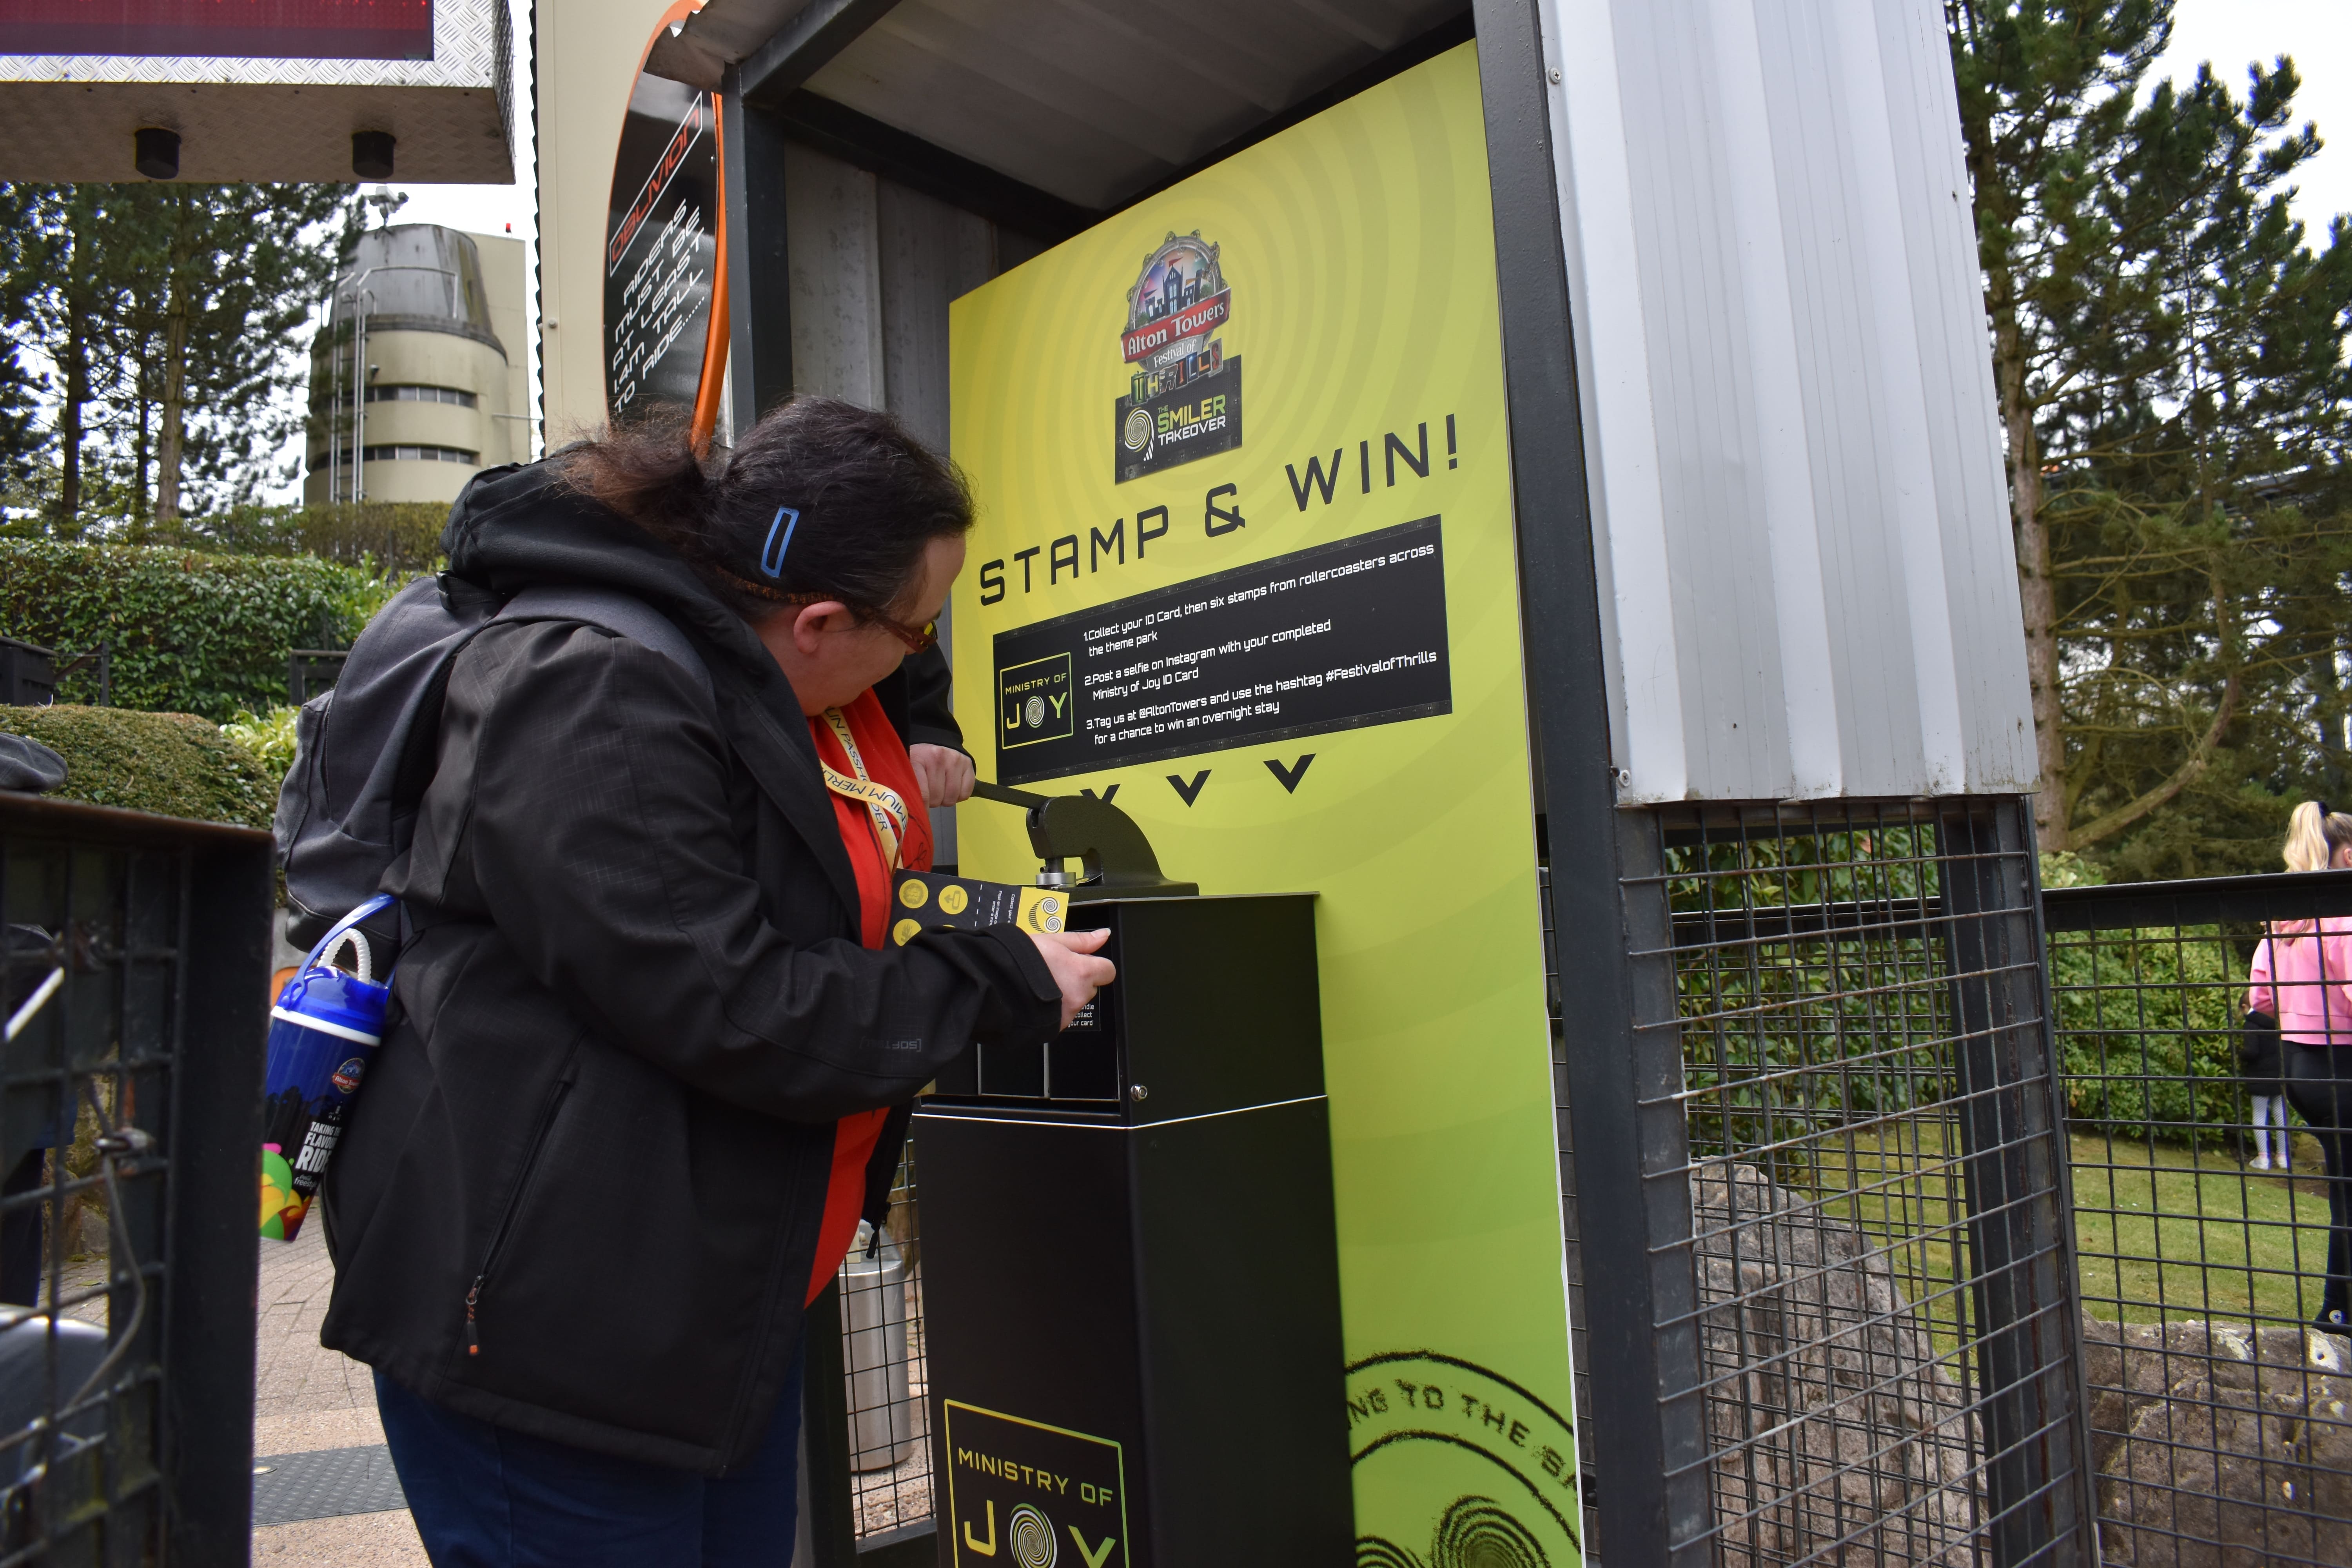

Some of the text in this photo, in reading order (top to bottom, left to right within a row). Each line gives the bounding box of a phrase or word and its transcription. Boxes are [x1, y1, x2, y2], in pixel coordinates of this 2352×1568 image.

[623, 198, 686, 306] RIDERS
[615, 205, 700, 343] MUST BE
[613, 227, 705, 371] AT LEAST
[652, 268, 704, 334] TALL
[1127, 301, 1225, 356] Alton Towers
[1132, 343, 1221, 401] THRILLS
[1153, 339, 1198, 368] Festival of
[614, 383, 635, 413] TO
[1157, 394, 1226, 434] SMILER
[1158, 405, 1169, 413] THE
[1158, 415, 1226, 446] TAKEOVER
[979, 413, 1459, 606] STAMP & WIN!
[1083, 544, 1434, 642] 1.Collect your ID Card, then six stamps from rollercoasters across
[1084, 619, 1331, 686] 2.Post a selfie on Instagram with your completed
[1089, 630, 1158, 657] the theme park
[1005, 672, 1067, 695] MINISTRY OF
[1086, 651, 1437, 730] 3.Tag us at @AltonTowers and use the hashtag #FestivalofThrills
[1093, 667, 1199, 701] Ministry of Joy ID Card
[824, 707, 845, 729] LIN
[1006, 691, 1068, 729] JOY
[1094, 701, 1279, 745] for a chance to win an overnight stay
[334, 1075, 348, 1085] Alton
[304, 1132, 338, 1149] FLAVOU
[310, 1121, 335, 1136] TAKING
[1393, 1378, 1444, 1410] TO
[1461, 1393, 1531, 1448] THE
[958, 1447, 1113, 1507] MINISTRY OF
